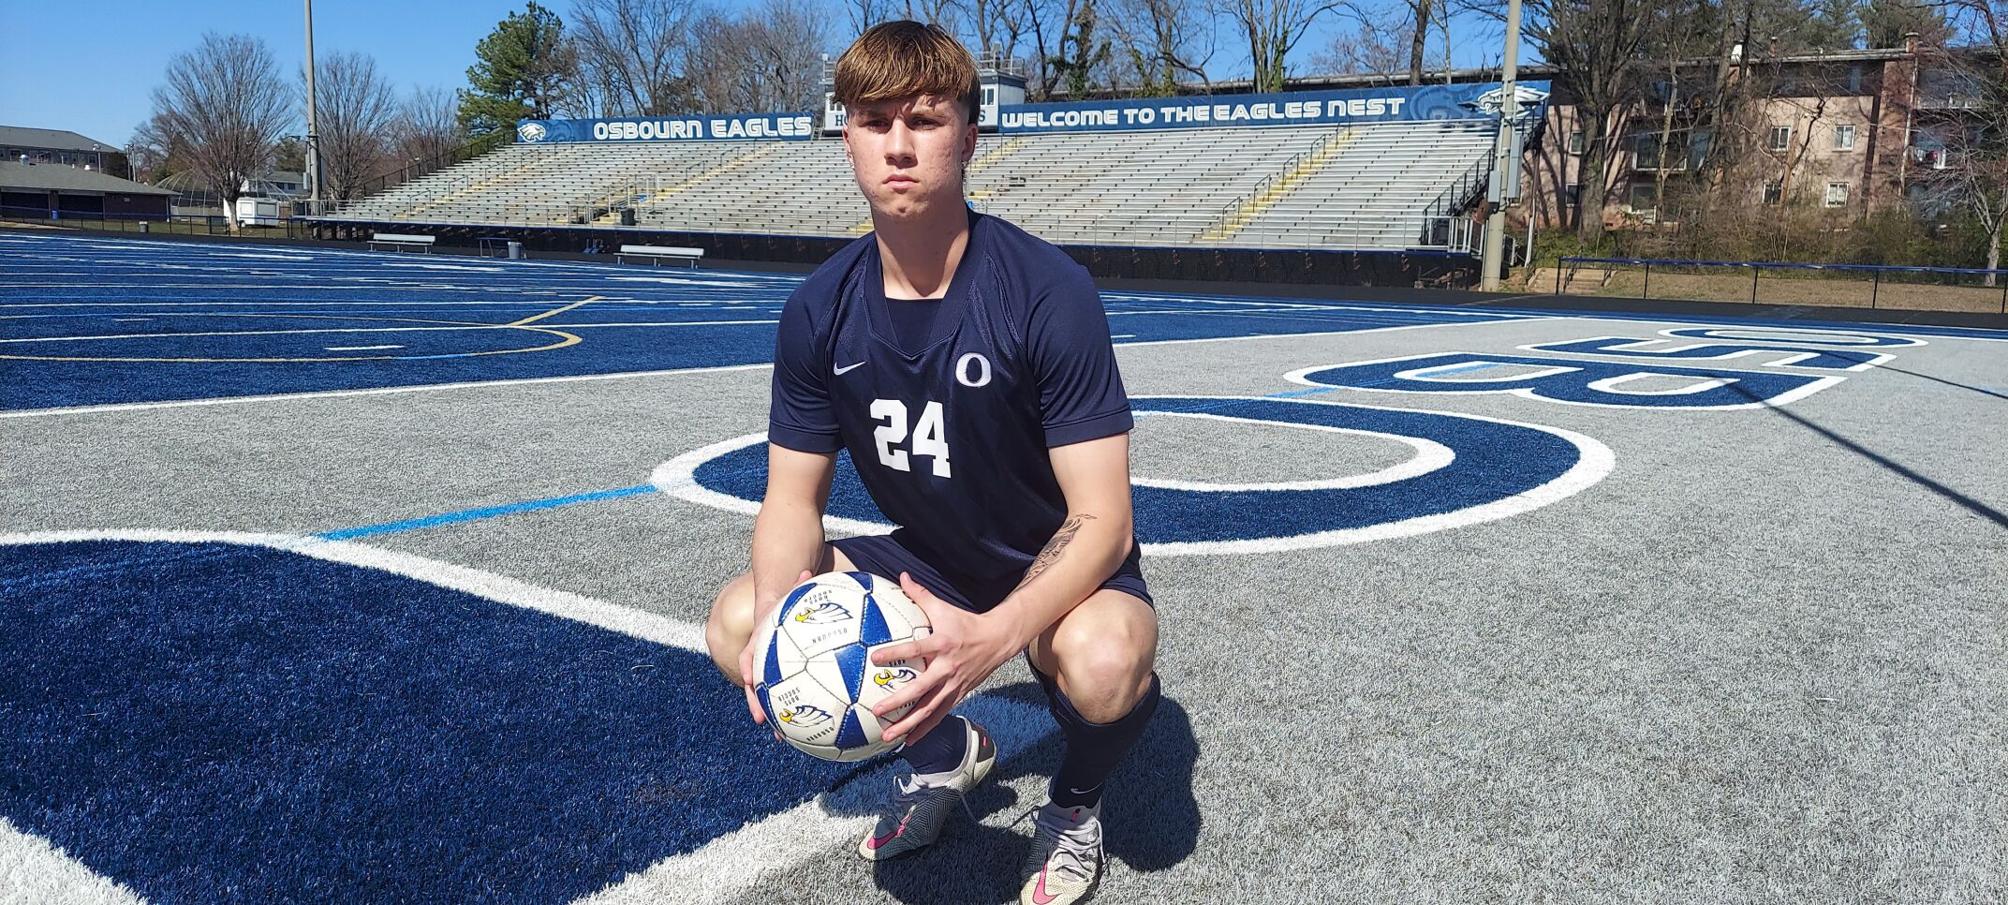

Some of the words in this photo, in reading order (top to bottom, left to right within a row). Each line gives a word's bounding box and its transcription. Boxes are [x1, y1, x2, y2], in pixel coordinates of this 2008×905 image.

[593, 120, 703, 140] OSBOURN
[711, 117, 812, 138] EAGLES
[1001, 109, 1118, 128] WELCOME
[1124, 107, 1155, 124] TO
[1160, 105, 1210, 123] THE
[1213, 101, 1321, 120] EAGLES
[1327, 97, 1406, 117] NEST
[955, 352, 992, 388] O
[869, 398, 952, 478] 24
